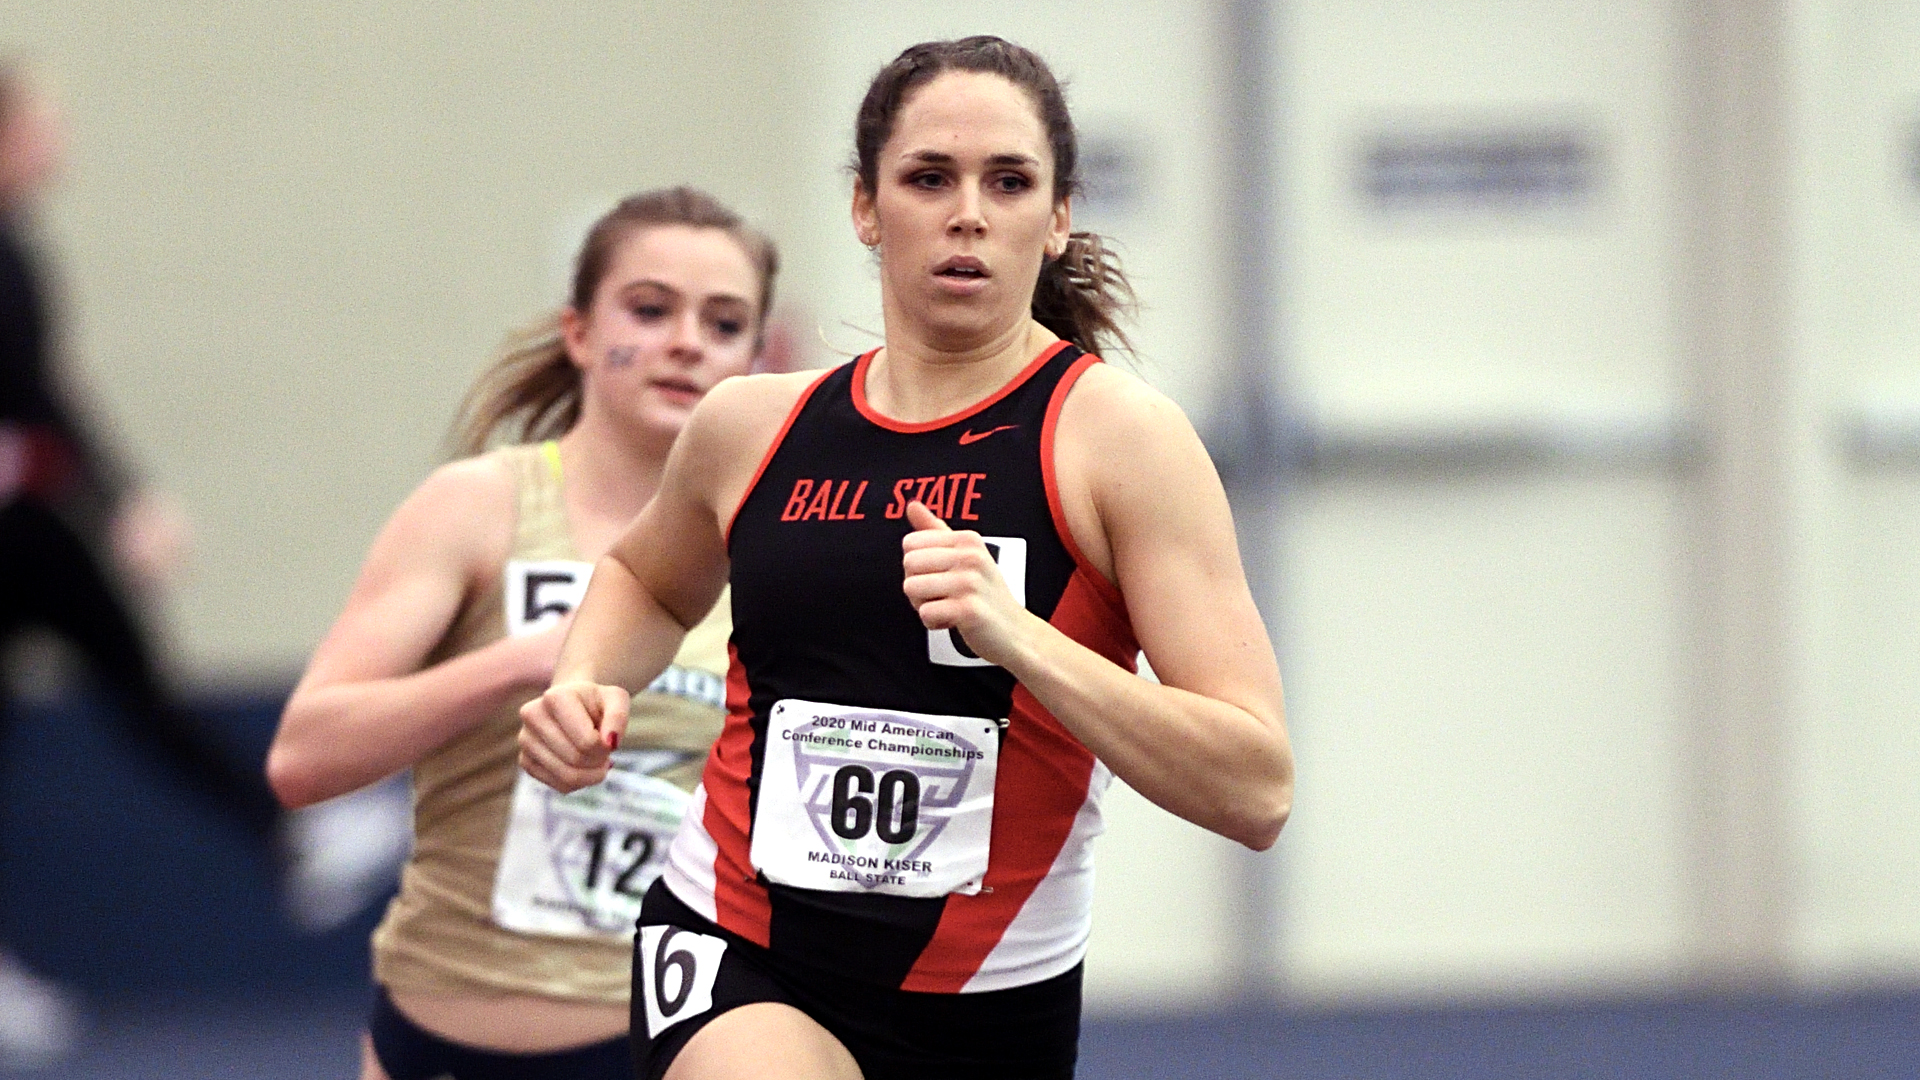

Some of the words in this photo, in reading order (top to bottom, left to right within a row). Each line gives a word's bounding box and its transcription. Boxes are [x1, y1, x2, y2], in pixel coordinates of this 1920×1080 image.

[781, 478, 869, 522] BALL
[884, 473, 987, 521] STATE
[781, 729, 863, 749] Conference
[867, 738, 984, 760] Championships
[811, 715, 846, 730] 2020
[850, 719, 877, 733] Mid
[881, 722, 955, 741] American
[830, 764, 921, 845] 60
[584, 825, 656, 900] 12
[807, 851, 879, 868] MADISON
[884, 859, 932, 873] KISER
[829, 869, 860, 881] BALL
[865, 873, 907, 886] STATE
[654, 924, 697, 1018] 6
